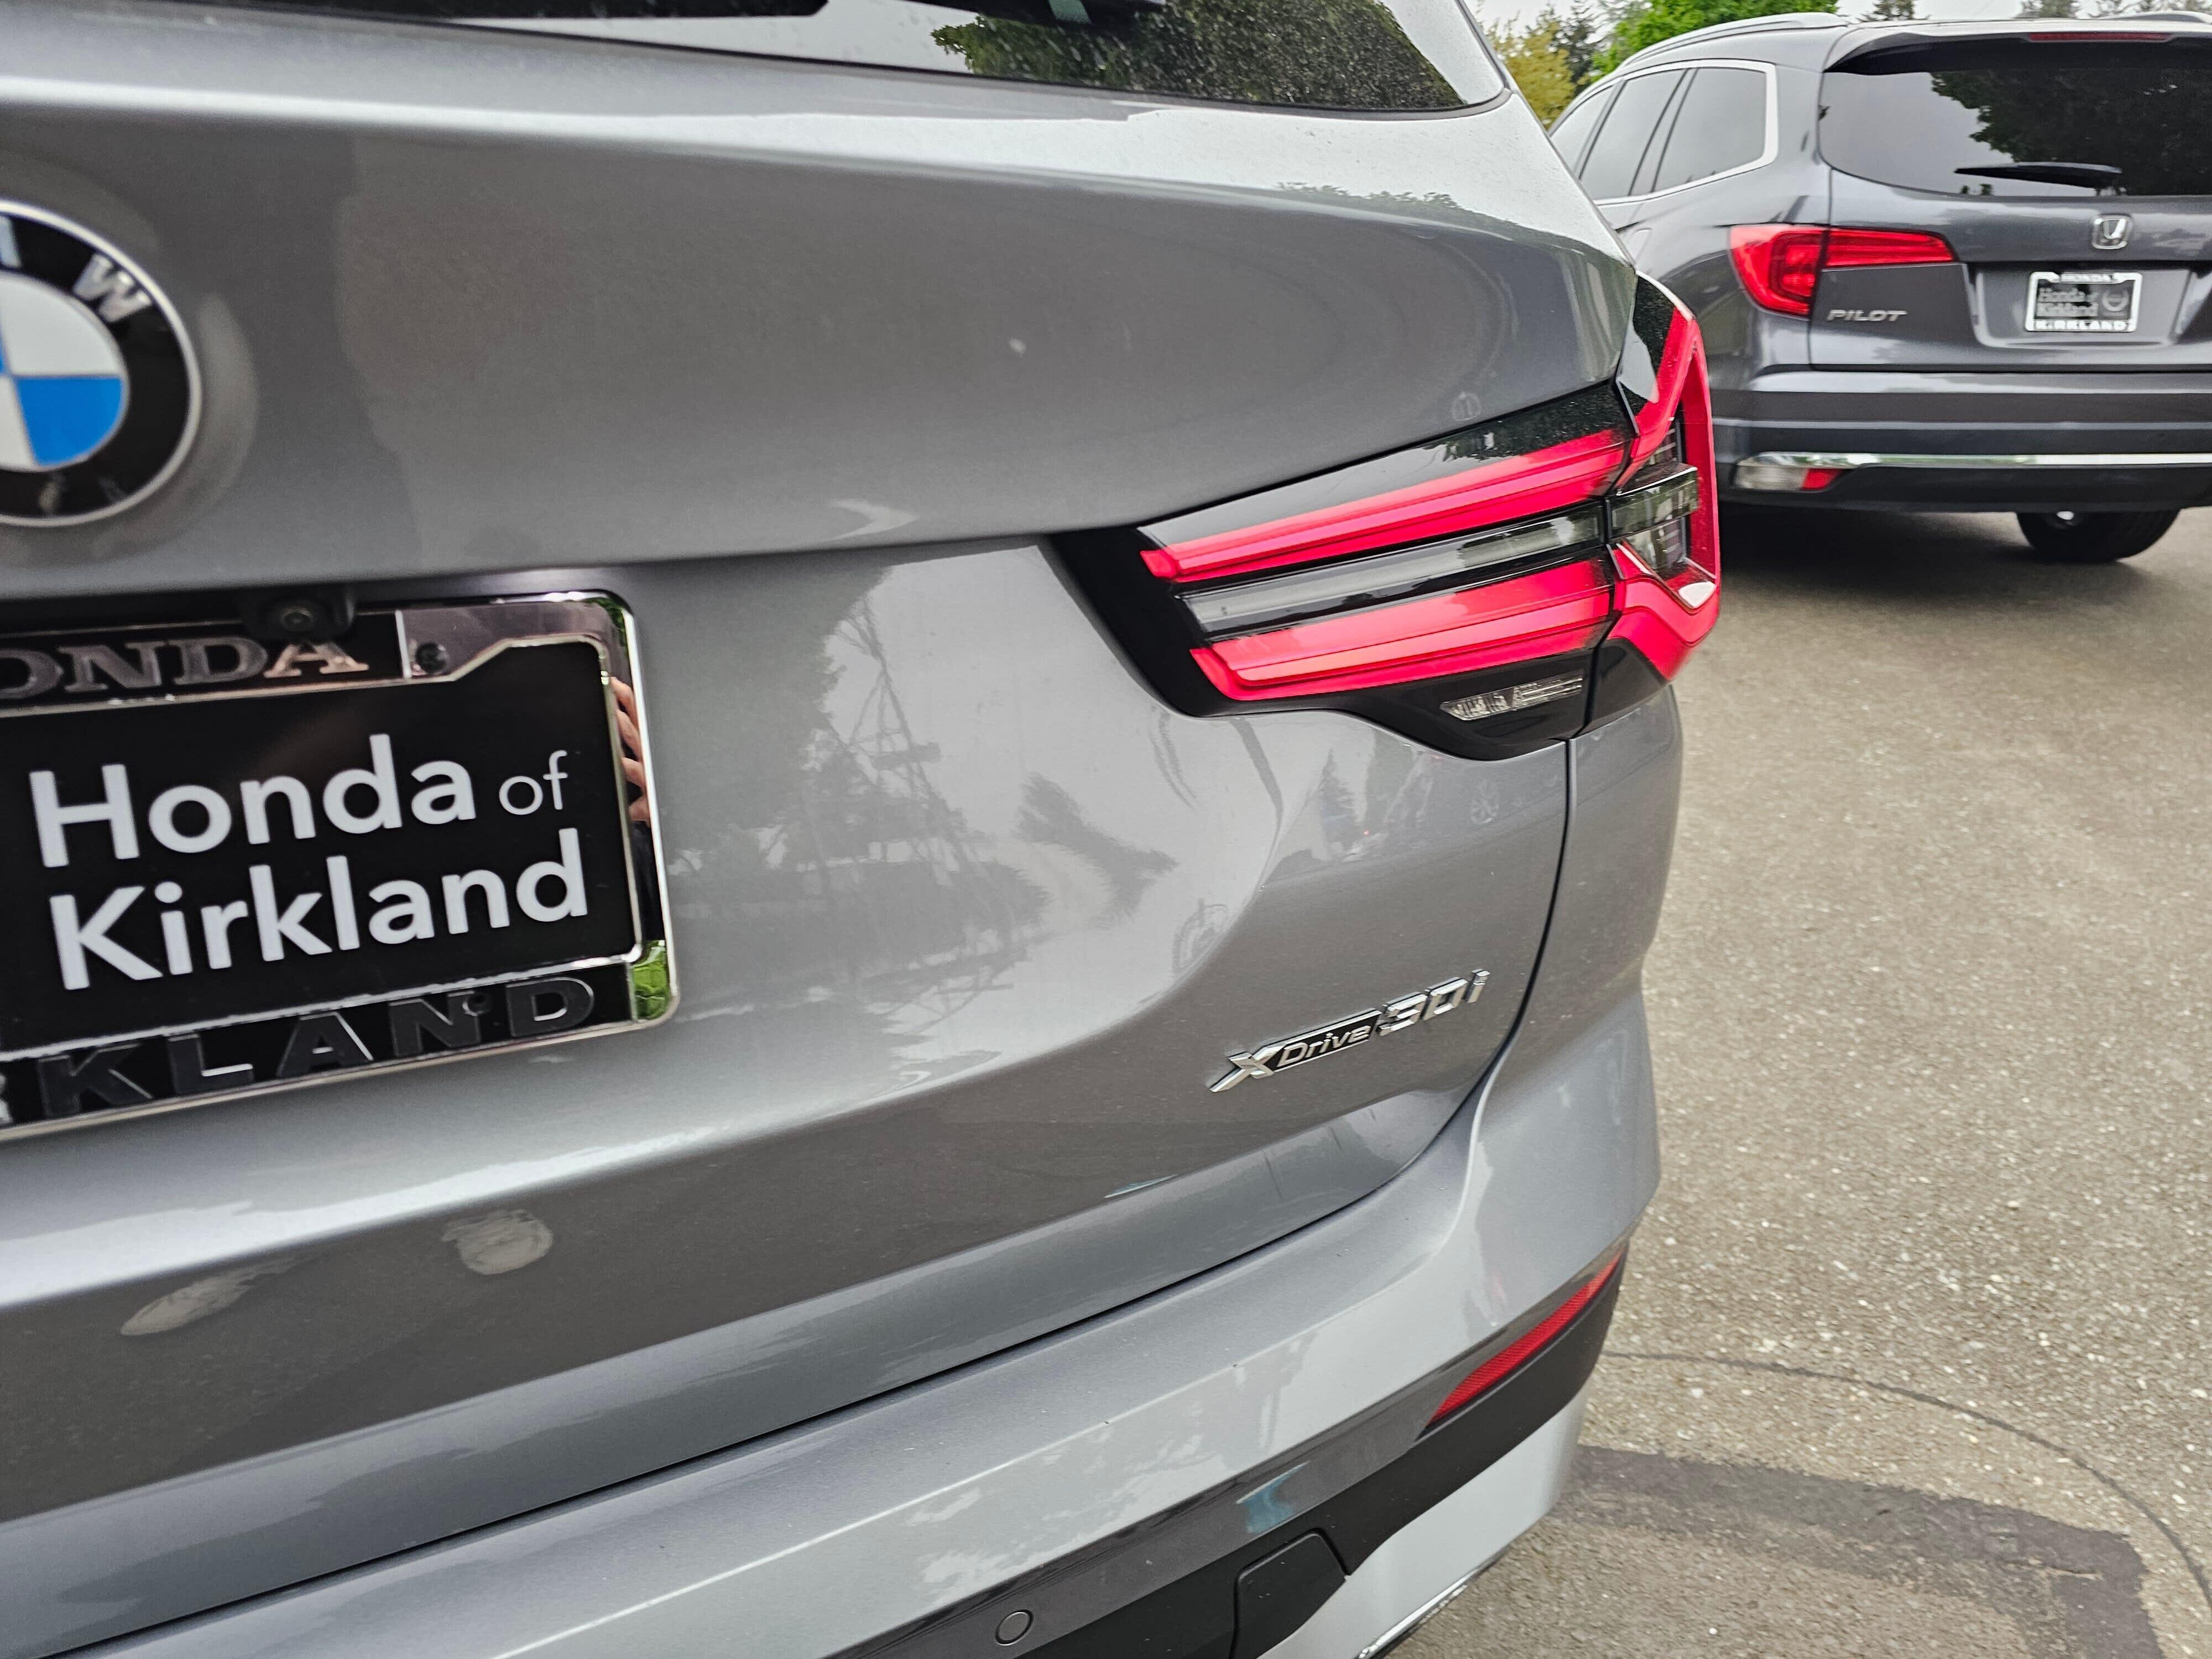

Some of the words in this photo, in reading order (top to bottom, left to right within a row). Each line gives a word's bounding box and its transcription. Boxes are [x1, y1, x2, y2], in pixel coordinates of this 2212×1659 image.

[1827, 309, 1908, 321] PILOT
[29, 733, 476, 868] Honda
[499, 750, 568, 816] of
[49, 827, 588, 990] Kirkland
[0, 977, 595, 1125] KLAND
